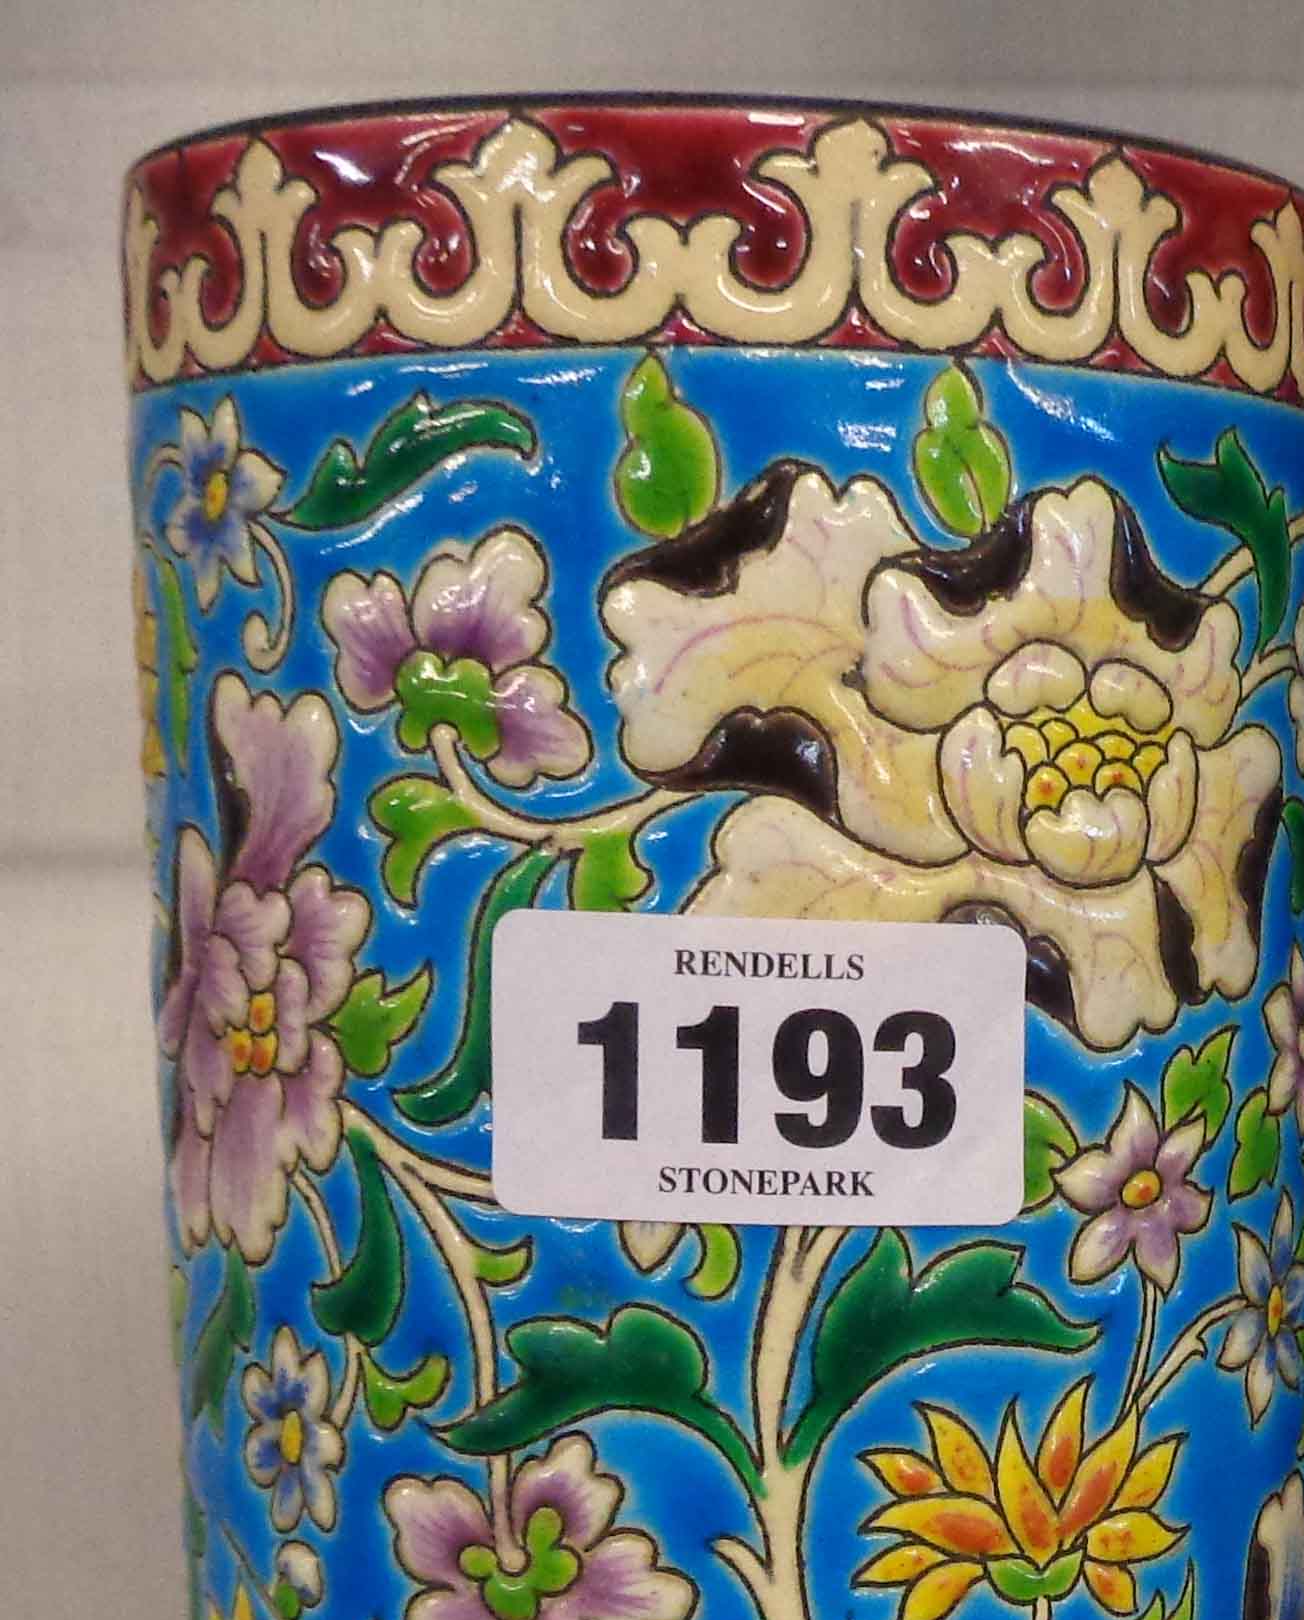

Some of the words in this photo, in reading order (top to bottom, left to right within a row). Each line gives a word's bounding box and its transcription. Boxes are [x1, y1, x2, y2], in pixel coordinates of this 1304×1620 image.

[674, 949, 865, 981] RENDELLS
[577, 1001, 957, 1150] 1193
[657, 1166, 875, 1197] STONEPARK
